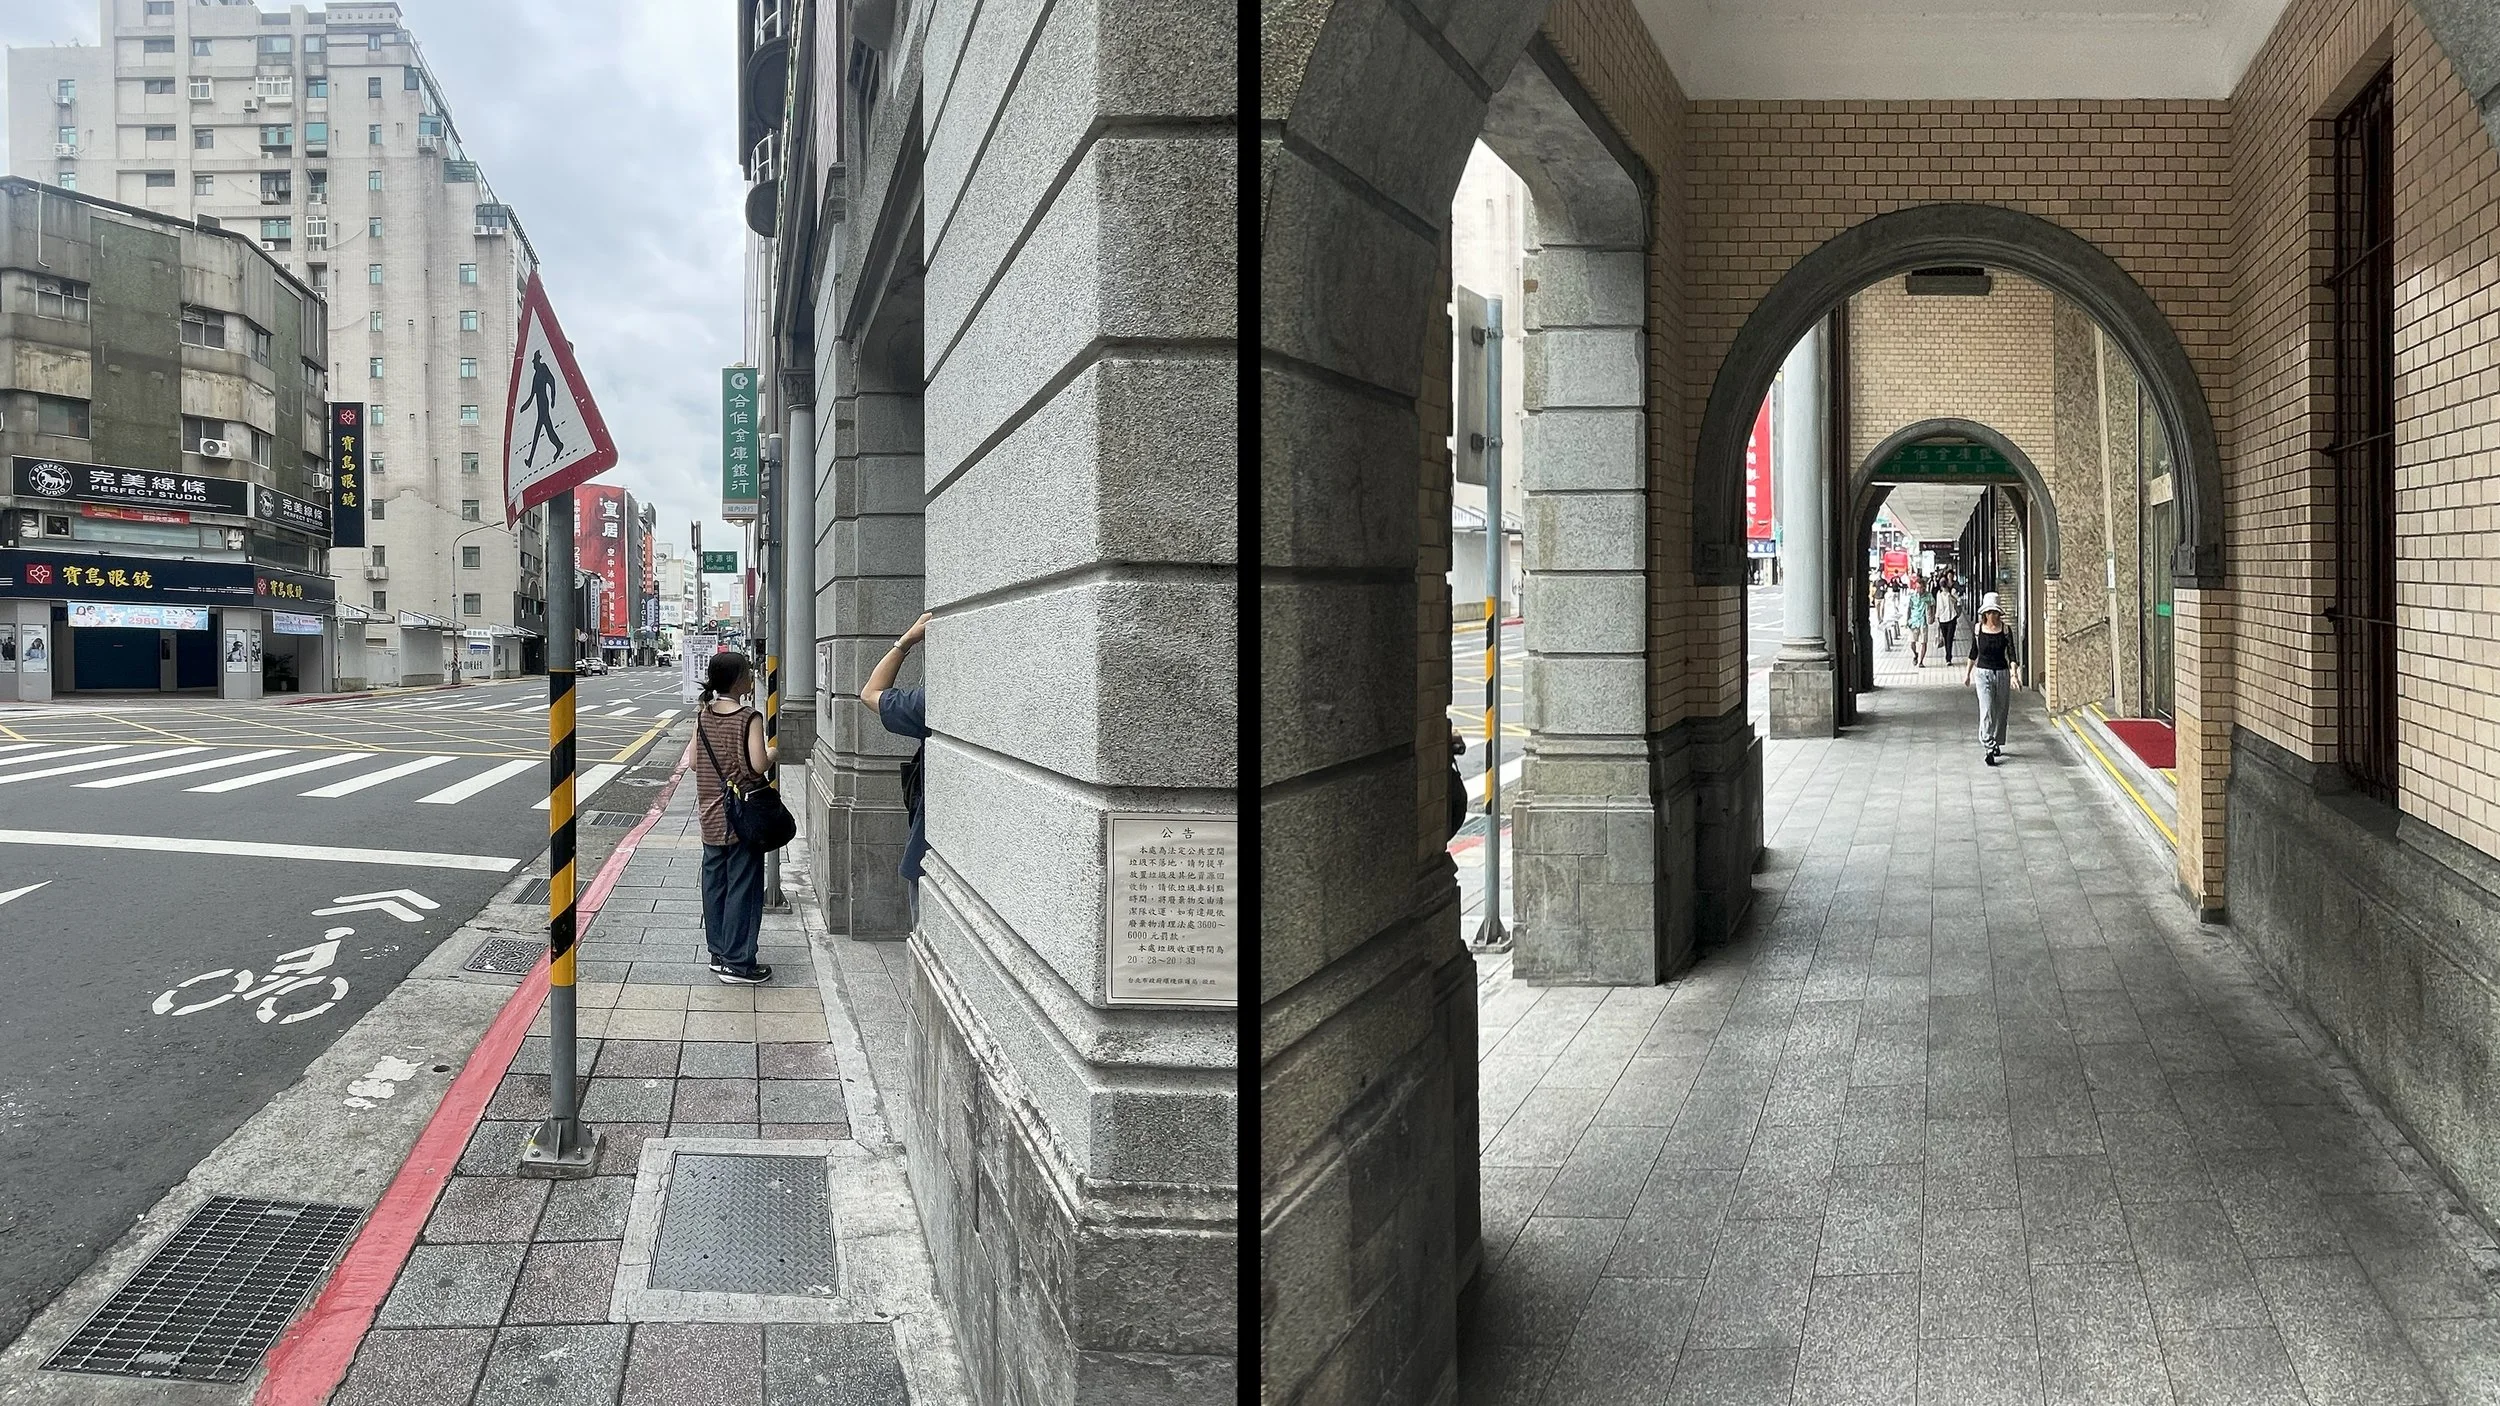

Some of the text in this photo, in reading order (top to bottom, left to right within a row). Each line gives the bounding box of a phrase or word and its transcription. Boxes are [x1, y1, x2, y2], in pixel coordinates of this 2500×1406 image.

[730, 393, 750, 494] 合作金庫銀行
[33, 463, 68, 474] PERFECT
[89, 470, 207, 494] 完美線條
[36, 485, 67, 496] STUDIO
[91, 484, 154, 497] PERFECT
[158, 491, 207, 502] STUDIO
[602, 500, 620, 539] 皇居
[62, 566, 153, 589] 寶島眼鏡
[128, 616, 160, 625] 2980
[1161, 826, 1195, 840] 公告
[1139, 845, 1225, 856] 本處為法定公共空間
[1129, 870, 1225, 880] 放置垃圾及其他資源回
[1138, 943, 1225, 954] 本處垃圾收運時間為
